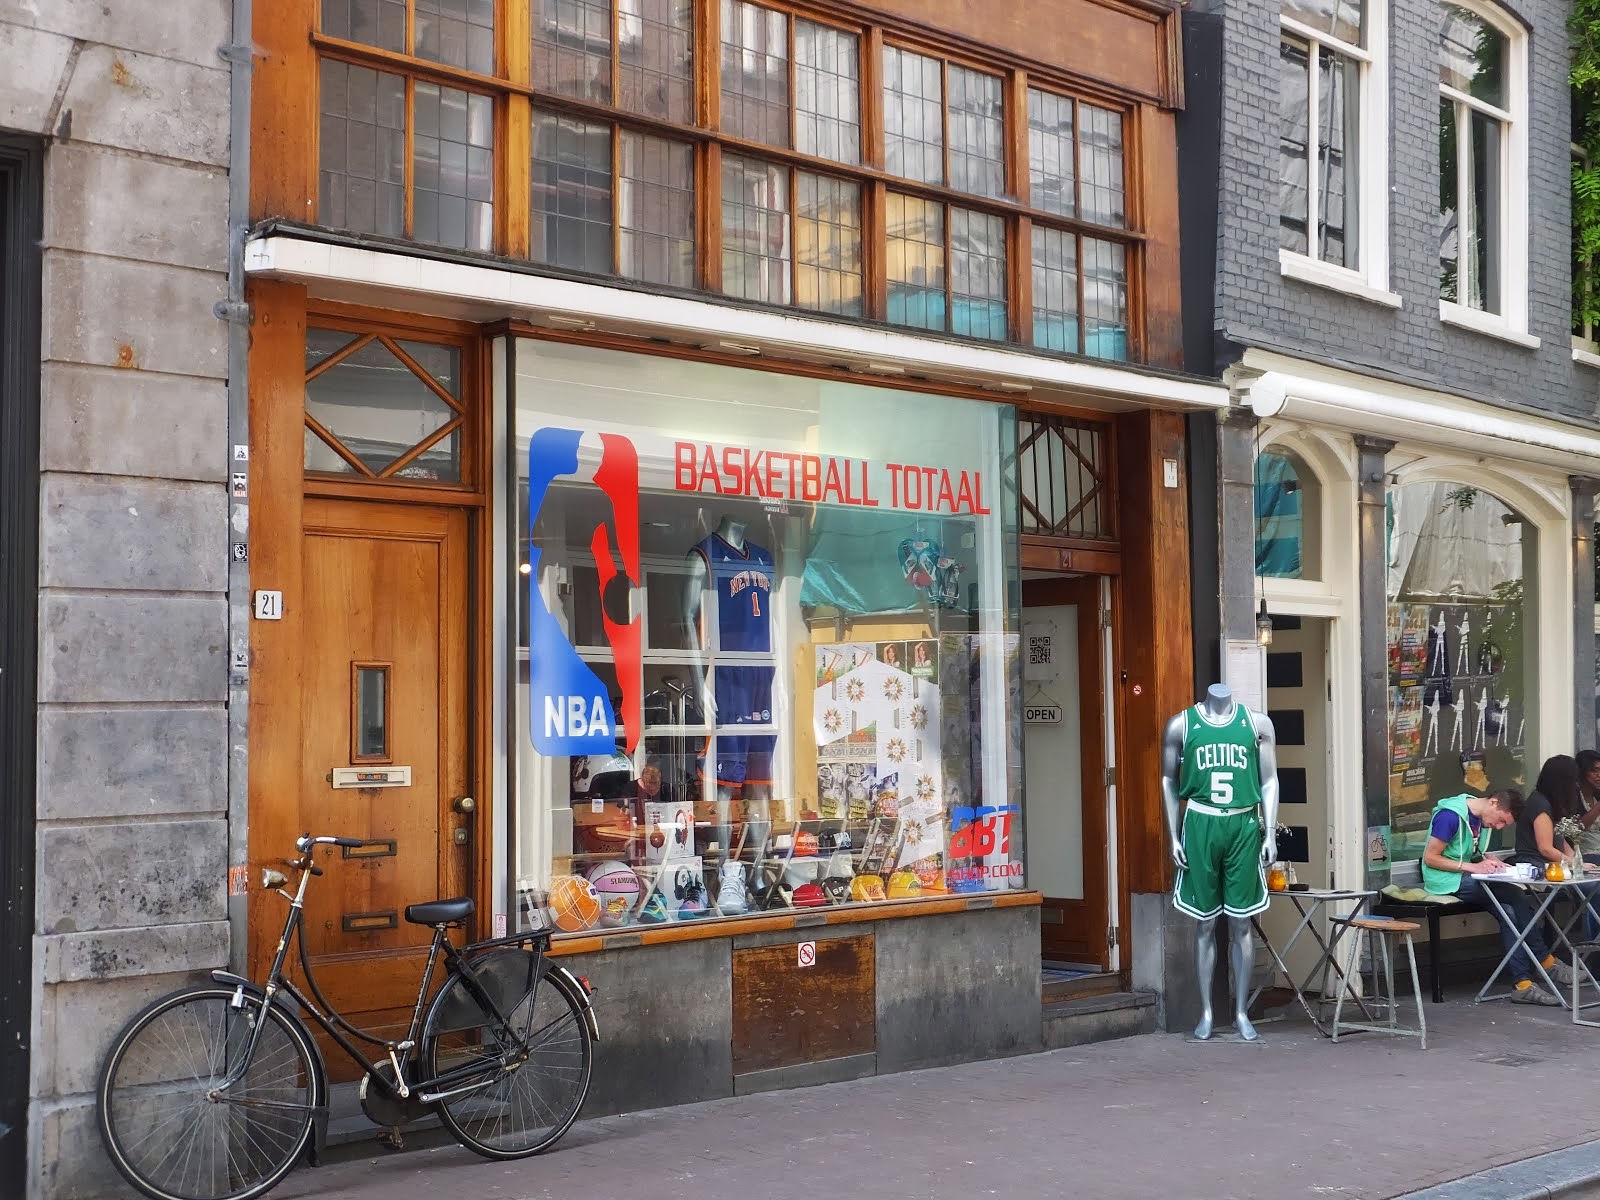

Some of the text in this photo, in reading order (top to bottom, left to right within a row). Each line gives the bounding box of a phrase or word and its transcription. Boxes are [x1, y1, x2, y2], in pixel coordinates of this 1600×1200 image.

[675, 441, 991, 515] BASKETBALL TOTAAL
[730, 571, 750, 598] NEW
[262, 594, 275, 614] 21
[752, 591, 760, 616] 1
[544, 695, 610, 738] NBA
[1026, 709, 1056, 720] OPEN
[1196, 743, 1248, 770] CELTICS
[1210, 771, 1233, 804] 5
[949, 804, 1018, 859] BBT
